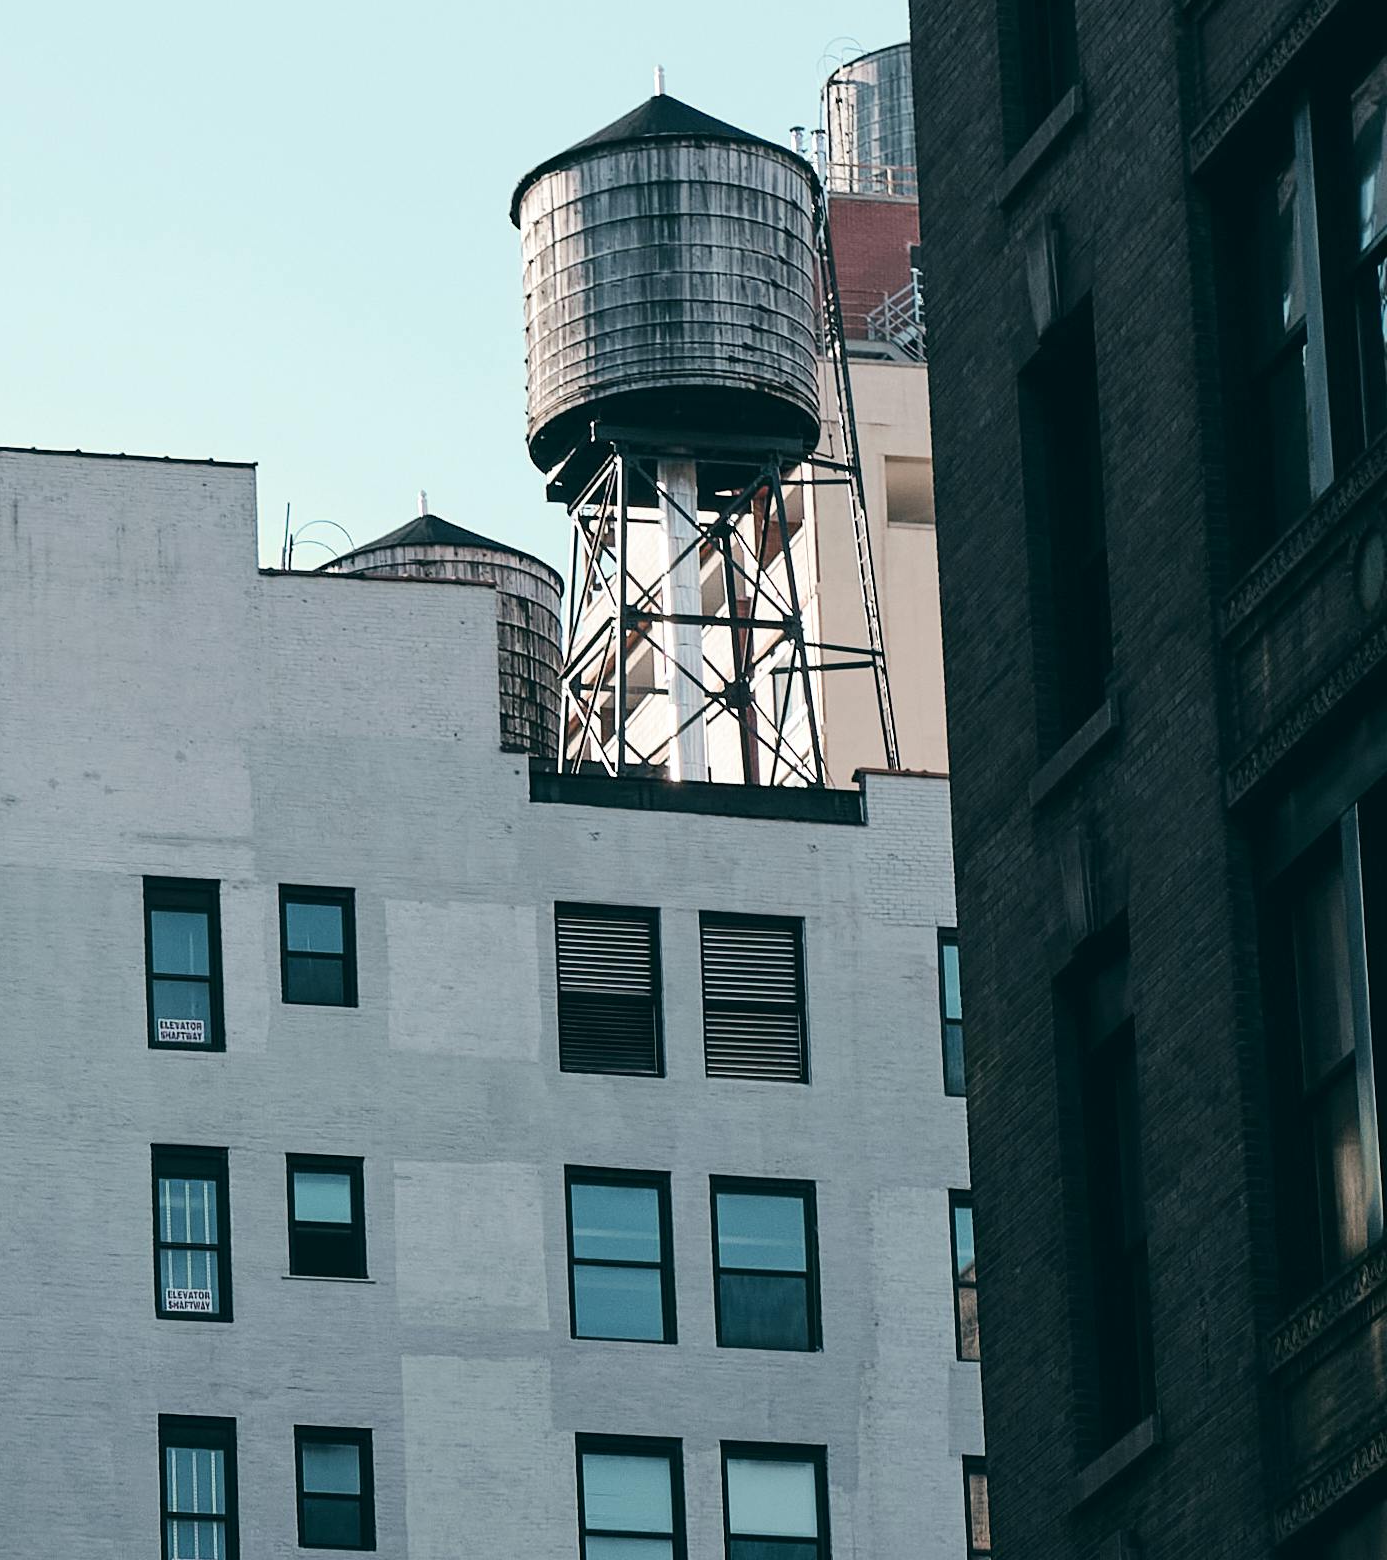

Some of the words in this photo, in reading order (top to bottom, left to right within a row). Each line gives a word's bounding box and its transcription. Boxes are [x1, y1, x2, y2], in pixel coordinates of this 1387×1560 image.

[159, 1020, 203, 1031] ELEVATOR
[160, 1031, 204, 1041] SHAFTWAY
[167, 1290, 211, 1300] ELEVATOR
[168, 1300, 211, 1311] SHAFTWAY
